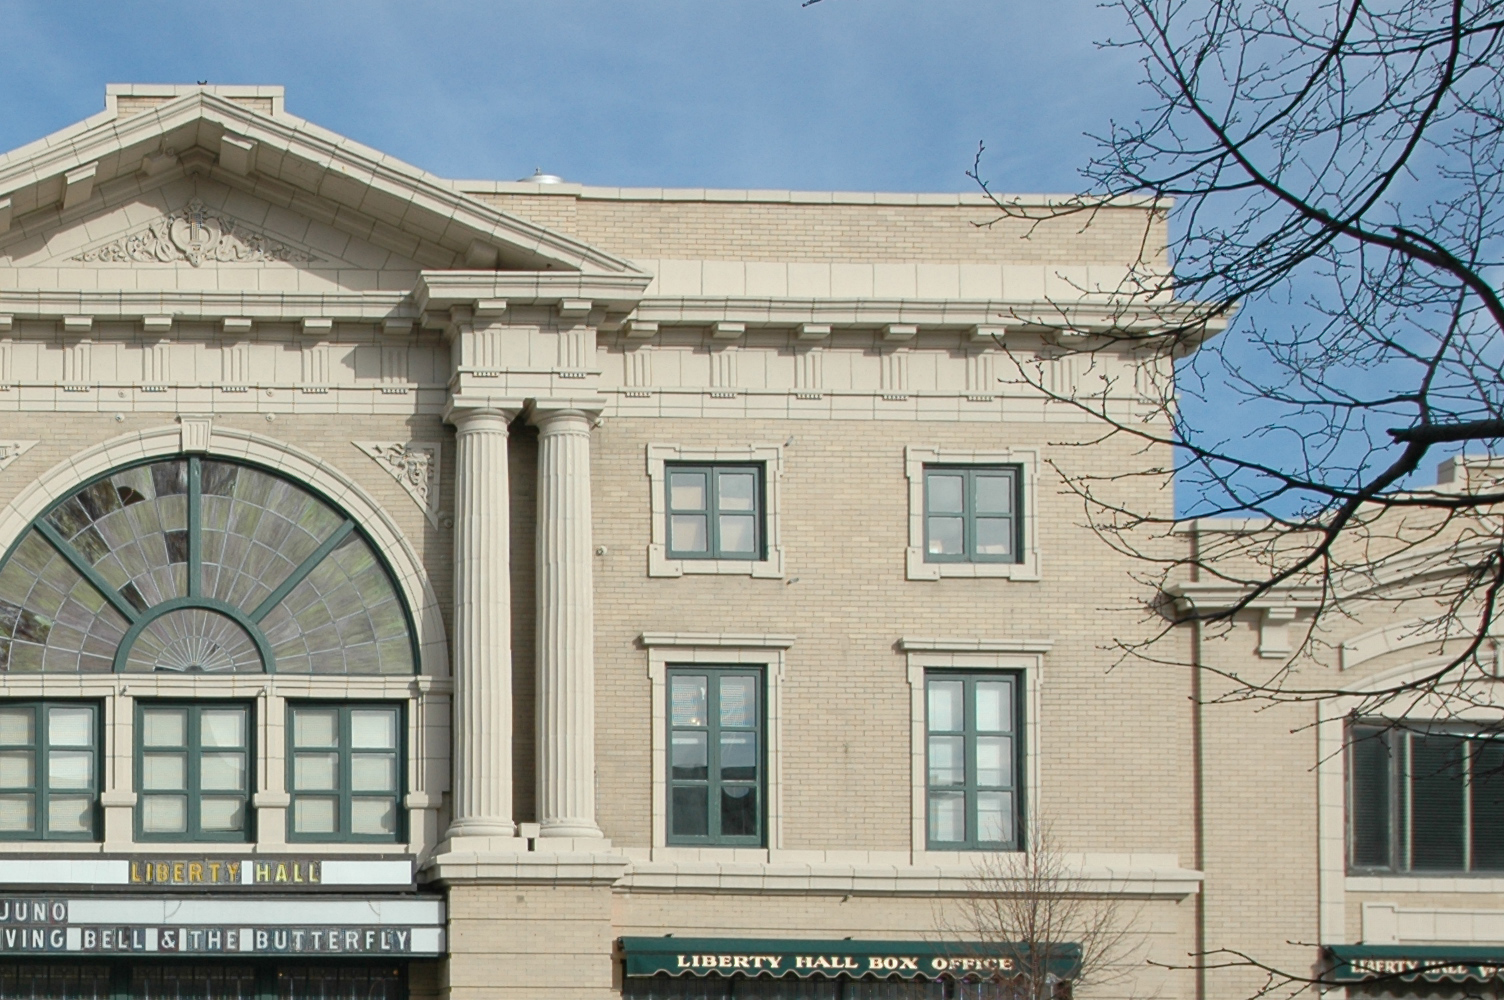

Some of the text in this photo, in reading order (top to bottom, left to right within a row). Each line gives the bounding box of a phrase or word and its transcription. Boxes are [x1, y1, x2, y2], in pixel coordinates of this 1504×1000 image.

[130, 861, 322, 883] LIBERTY HALL
[82, 929, 143, 949] BELL
[160, 931, 177, 949] &
[188, 931, 237, 950] THE
[255, 931, 409, 951] BUTTERFLY
[677, 955, 1013, 971] LIBERTY HALL BOX OFFICE
[1350, 959, 1419, 974] LIBERTY
